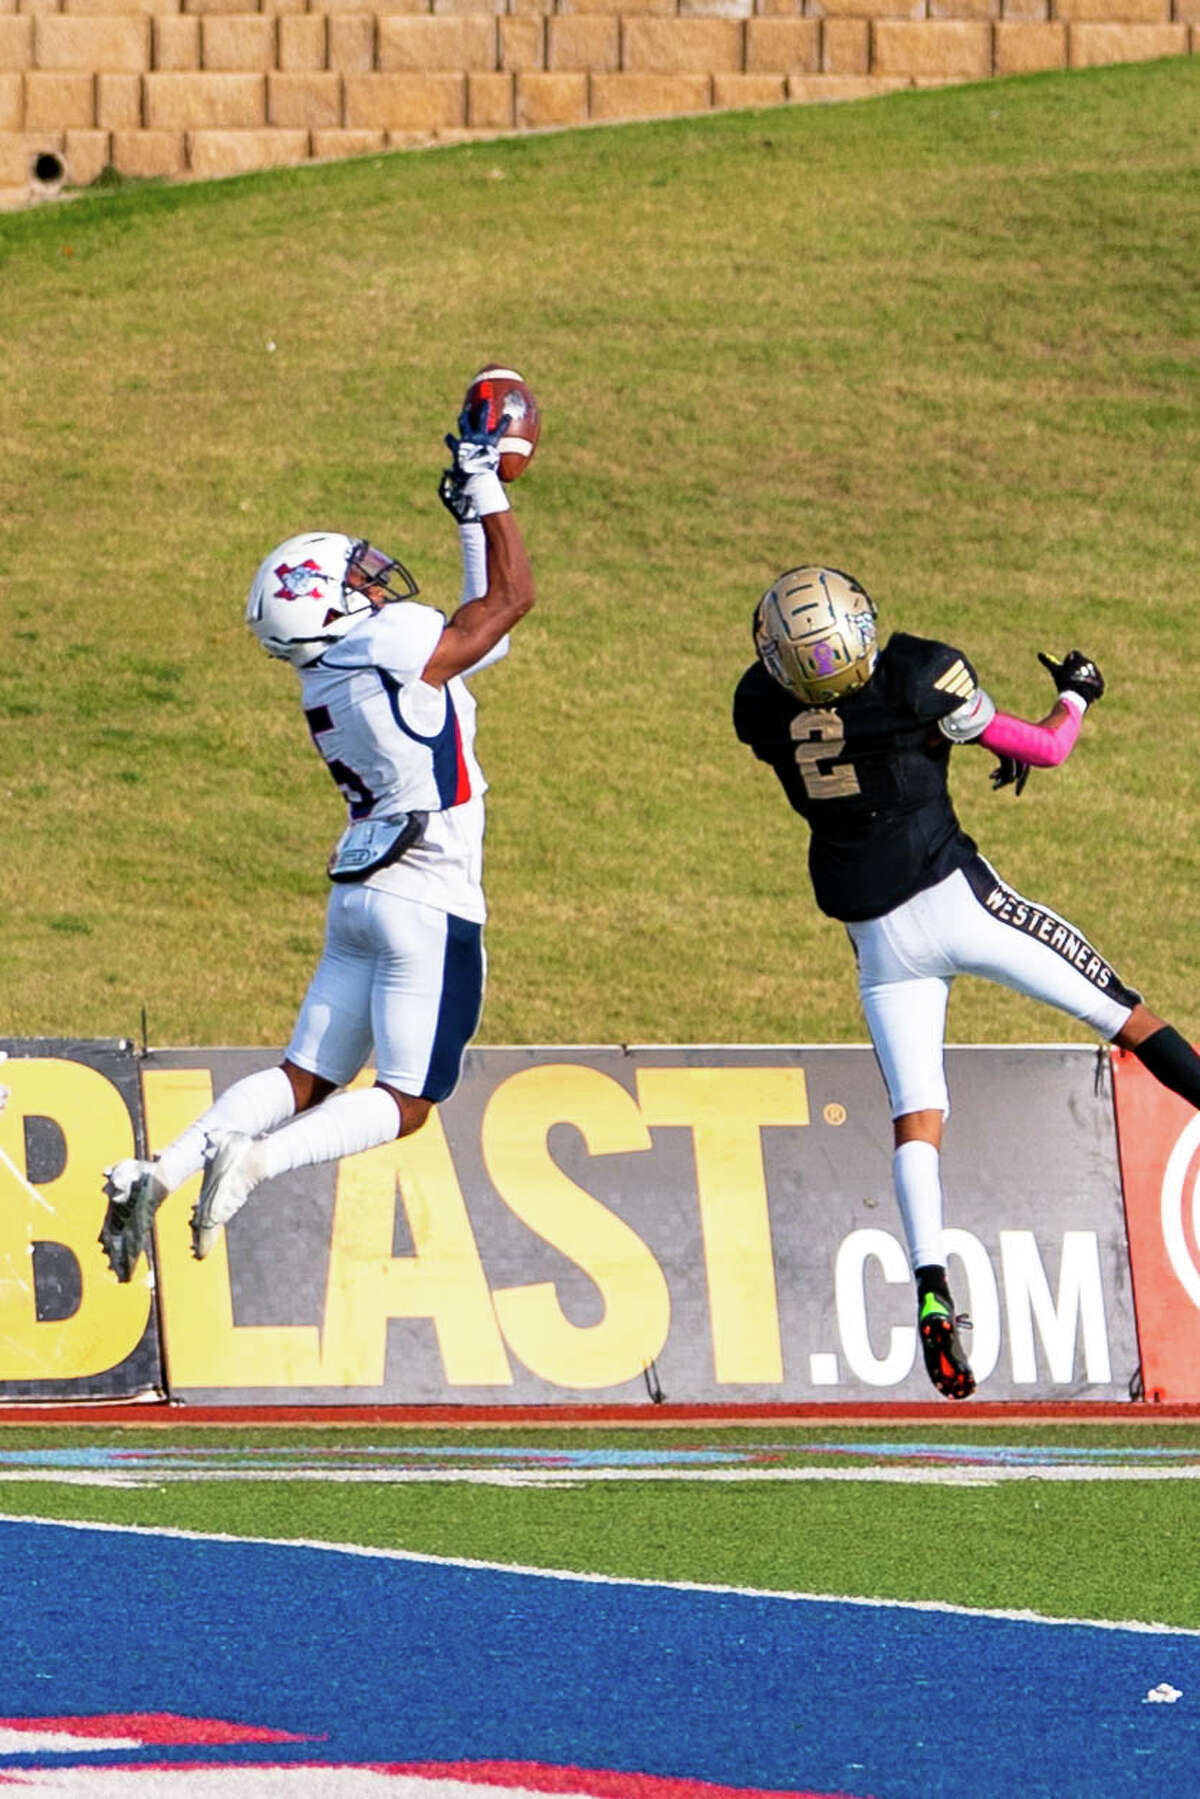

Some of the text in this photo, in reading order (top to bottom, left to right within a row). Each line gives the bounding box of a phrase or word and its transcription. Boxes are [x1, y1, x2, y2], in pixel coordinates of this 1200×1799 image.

[789, 708, 862, 799] 2
[985, 886, 1112, 988] WESTERNERS
[0, 1057, 810, 1389] BLAST
